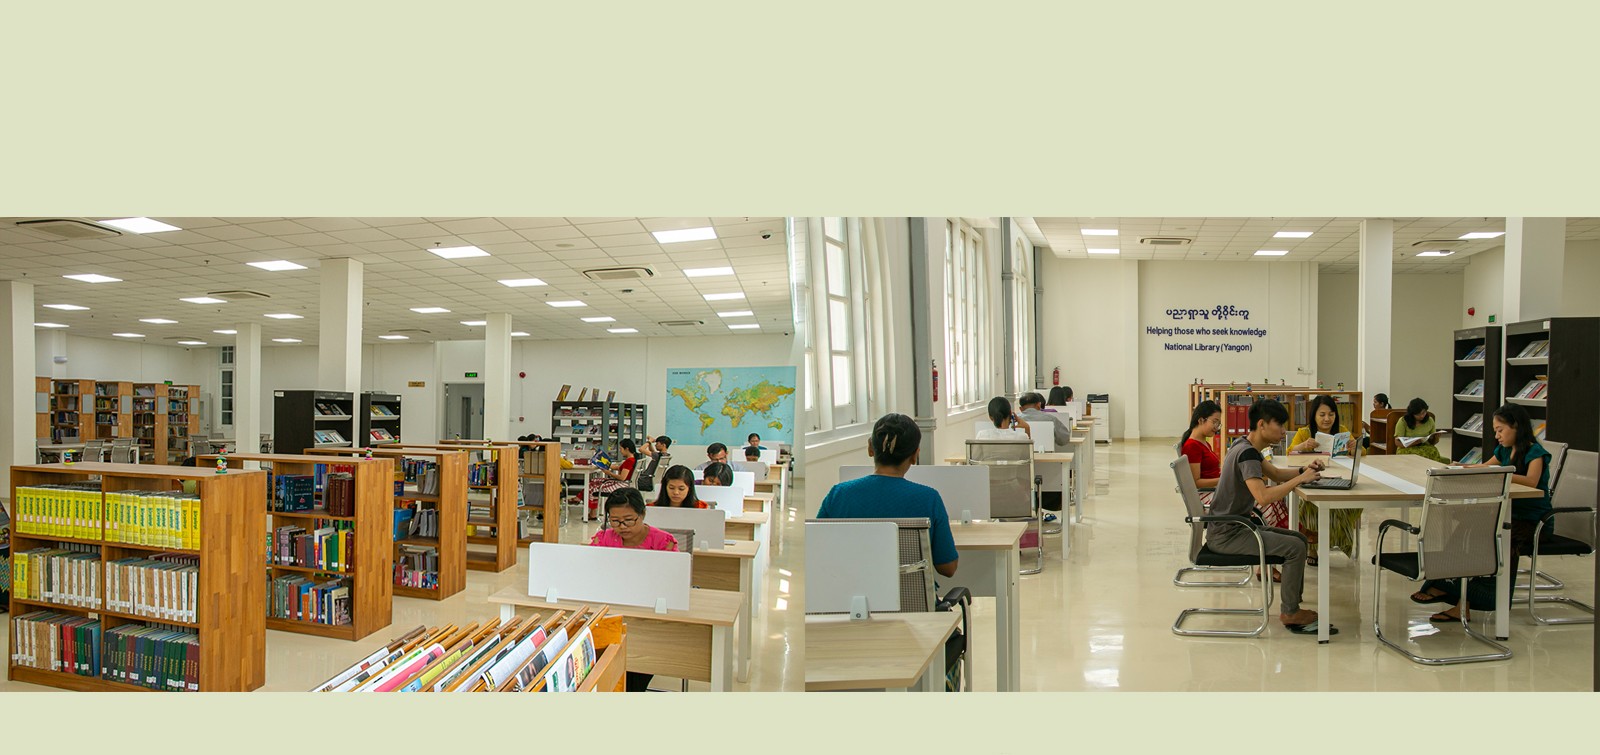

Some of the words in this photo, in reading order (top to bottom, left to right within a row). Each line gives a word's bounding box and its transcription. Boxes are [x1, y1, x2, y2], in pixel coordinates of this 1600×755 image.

[1146, 326, 1173, 337] Helping
[1174, 327, 1194, 336] those
[1195, 327, 1211, 336] who
[1212, 327, 1228, 336] seek
[1229, 327, 1267, 337] knowledge
[1164, 343, 1193, 351] National
